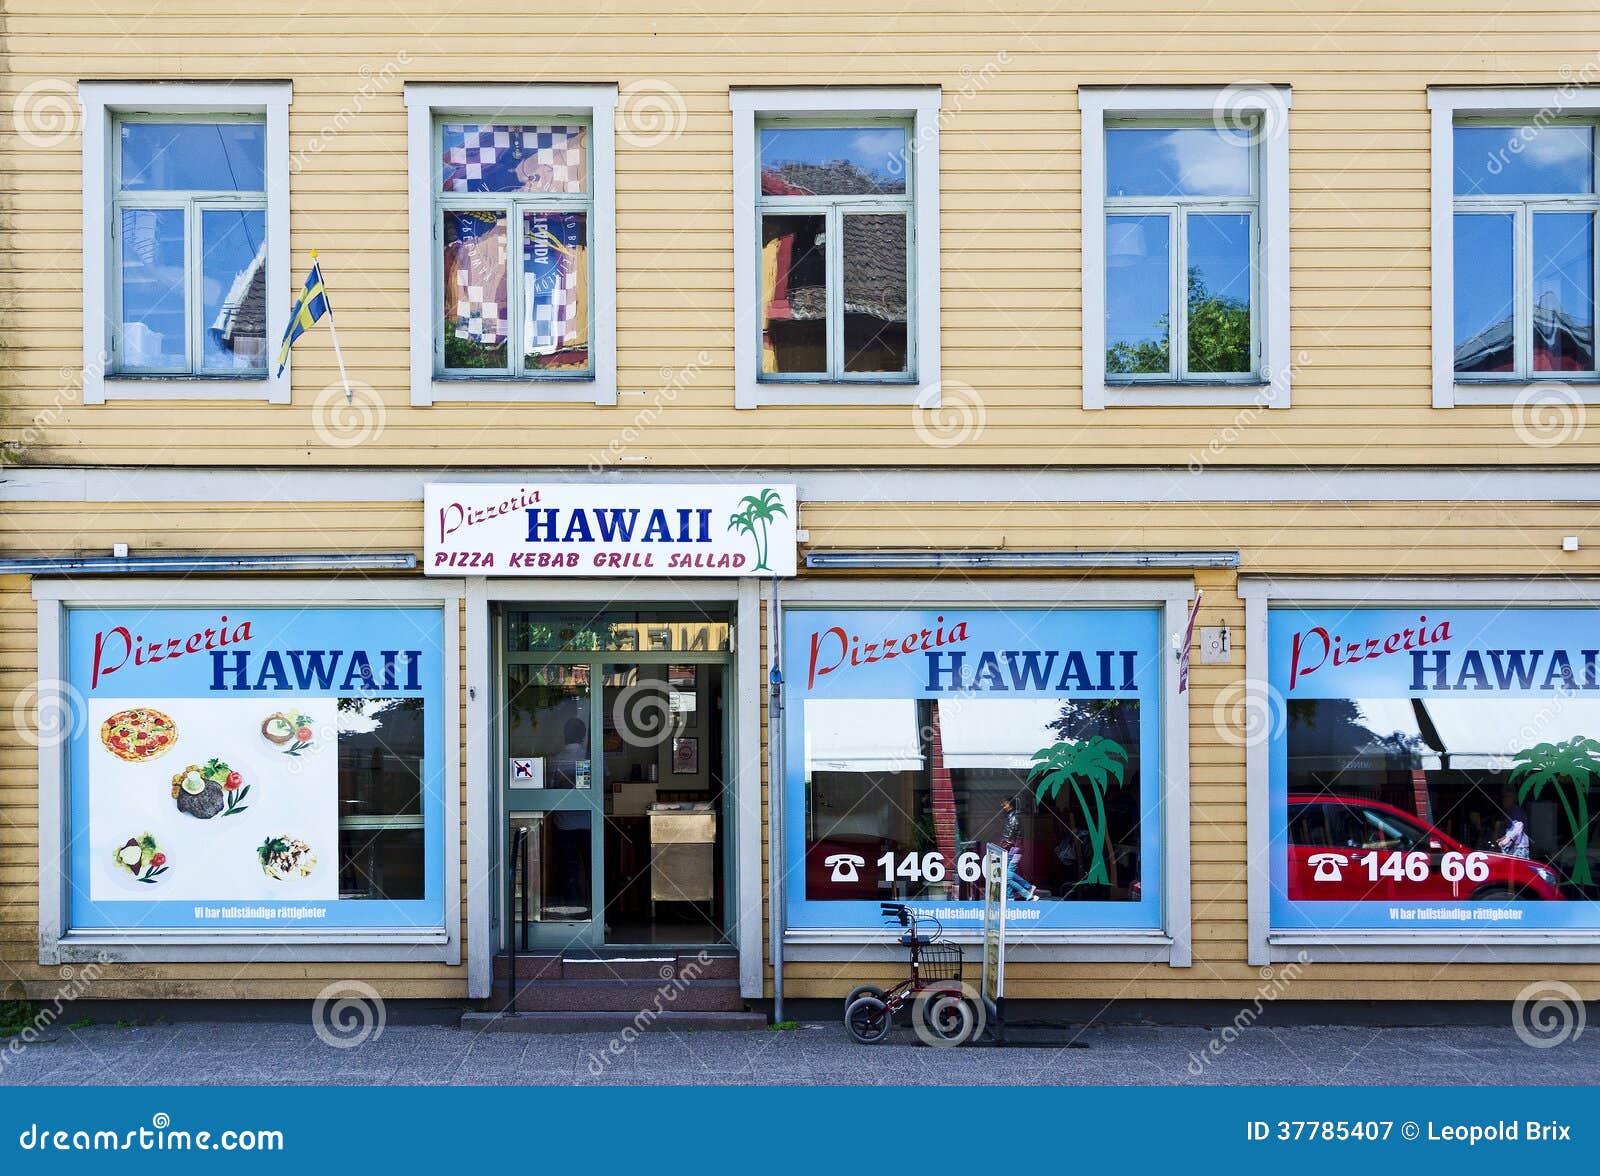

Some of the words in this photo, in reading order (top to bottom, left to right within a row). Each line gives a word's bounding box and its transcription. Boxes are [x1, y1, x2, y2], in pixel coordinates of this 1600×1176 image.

[438, 487, 542, 544] Pizzeria
[524, 507, 713, 543] HAWAII
[434, 551, 495, 568] PIZZA
[508, 551, 580, 568] KEBAB
[592, 552, 655, 568] GRILL
[667, 552, 747, 569] SALLAD
[91, 614, 256, 691] Pizzeria
[209, 650, 422, 691] HAWAII
[807, 615, 970, 691] Pizzeria
[924, 650, 1138, 691] HAWAII
[1289, 615, 1455, 692] Pizzeria
[877, 851, 946, 883] 146
[1360, 851, 1430, 882] 146
[1440, 851, 1490, 882] 66
[194, 907, 203, 919] Vi
[205, 906, 220, 919] har
[222, 906, 276, 920] fullständiga
[278, 906, 326, 920] rättigheter
[935, 906, 988, 920] fullständig
[1389, 908, 1399, 920] Vi
[1401, 907, 1415, 920] har
[1417, 907, 1471, 921] fullständiga
[1473, 907, 1522, 921] rättigheter
